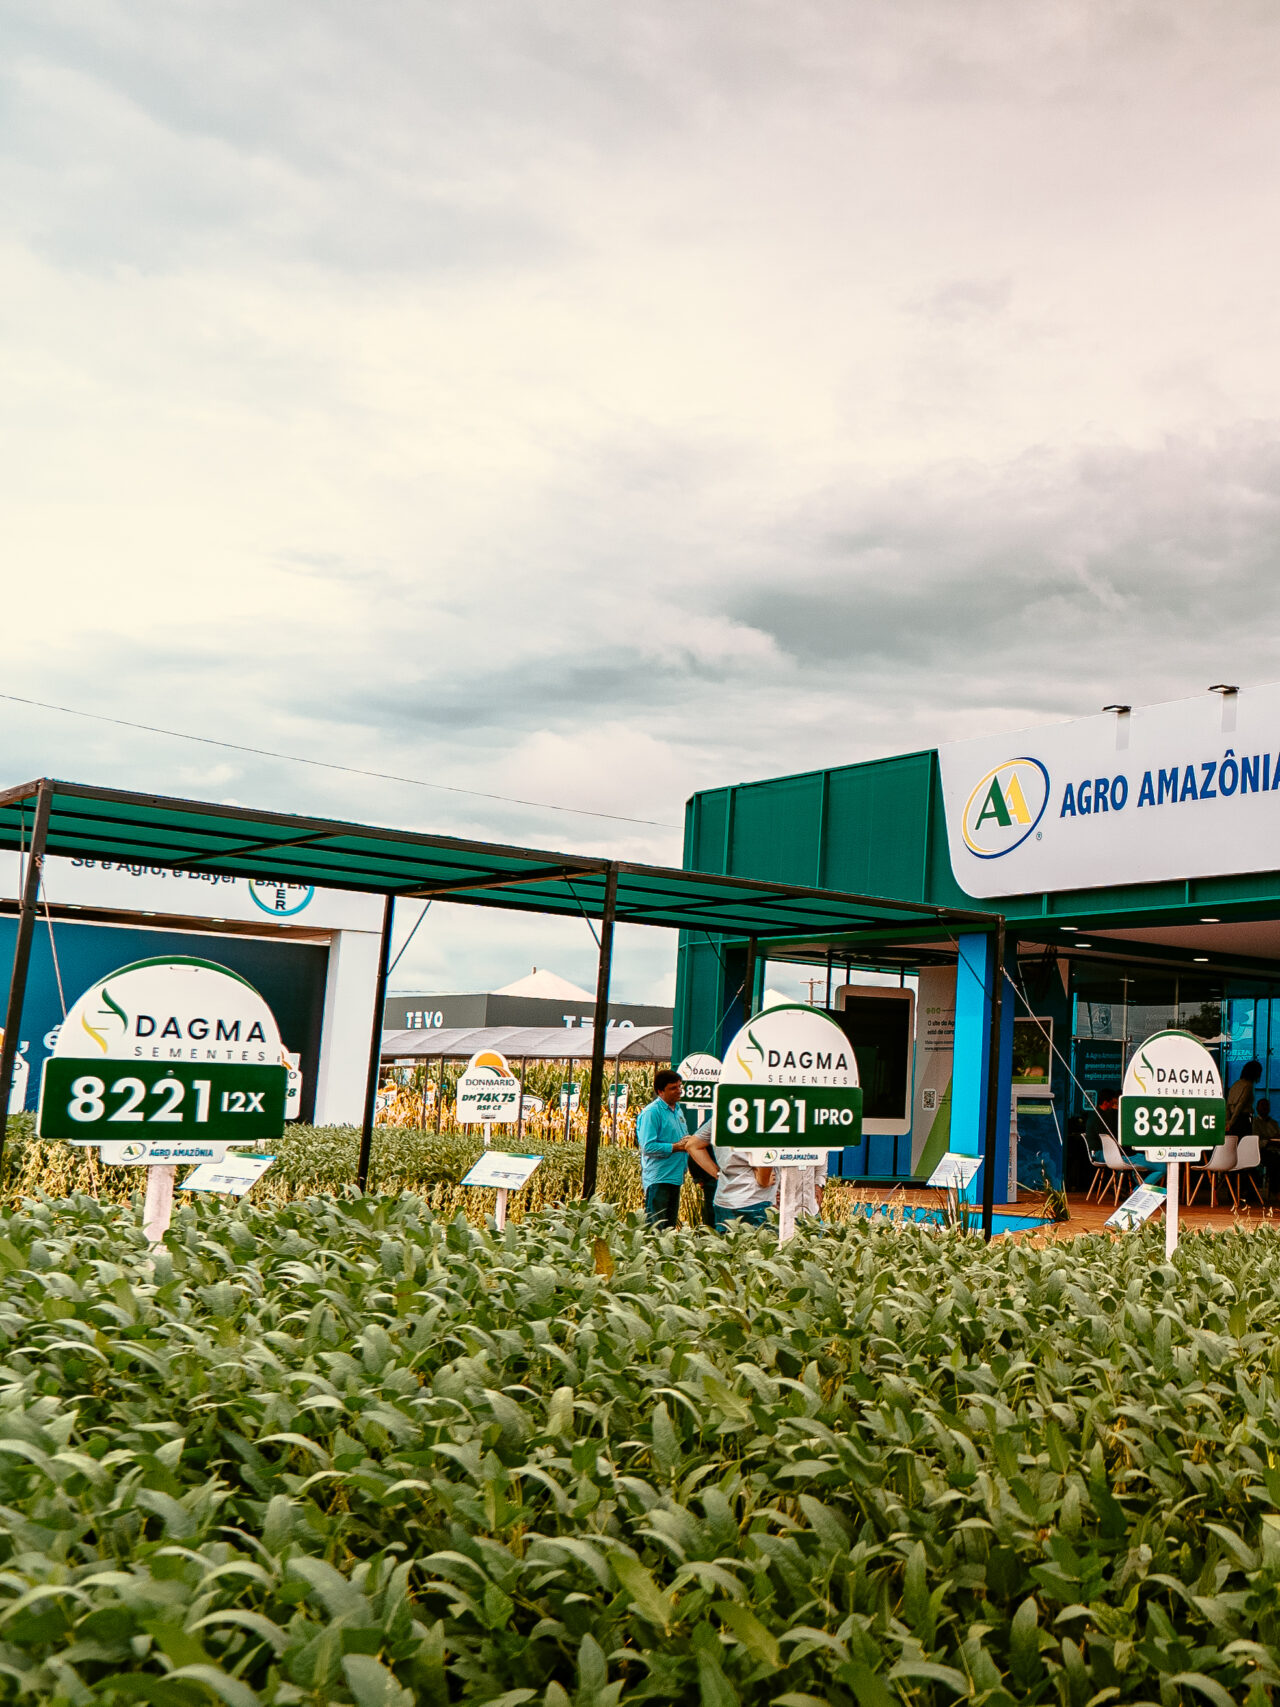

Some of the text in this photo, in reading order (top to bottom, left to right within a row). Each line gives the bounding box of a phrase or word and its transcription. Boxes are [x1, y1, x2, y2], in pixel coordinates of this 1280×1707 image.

[1059, 774, 1129, 819] AGRO
[135, 1015, 267, 1043] DAGMA
[405, 1011, 444, 1029] TEVO
[134, 1046, 265, 1061] SEMENTES
[768, 1050, 848, 1071] DAGMA
[465, 1078, 516, 1087] DONMARIO
[768, 1074, 848, 1085] SEMENTES
[1156, 1068, 1215, 1085] DAGMA
[67, 1075, 212, 1122] 8221
[1157, 1088, 1215, 1096] SEMENTES
[726, 1097, 854, 1134] 8121 IPRO
[1134, 1106, 1216, 1136] 8321 CE
[149, 1148, 171, 1157] AGRO
